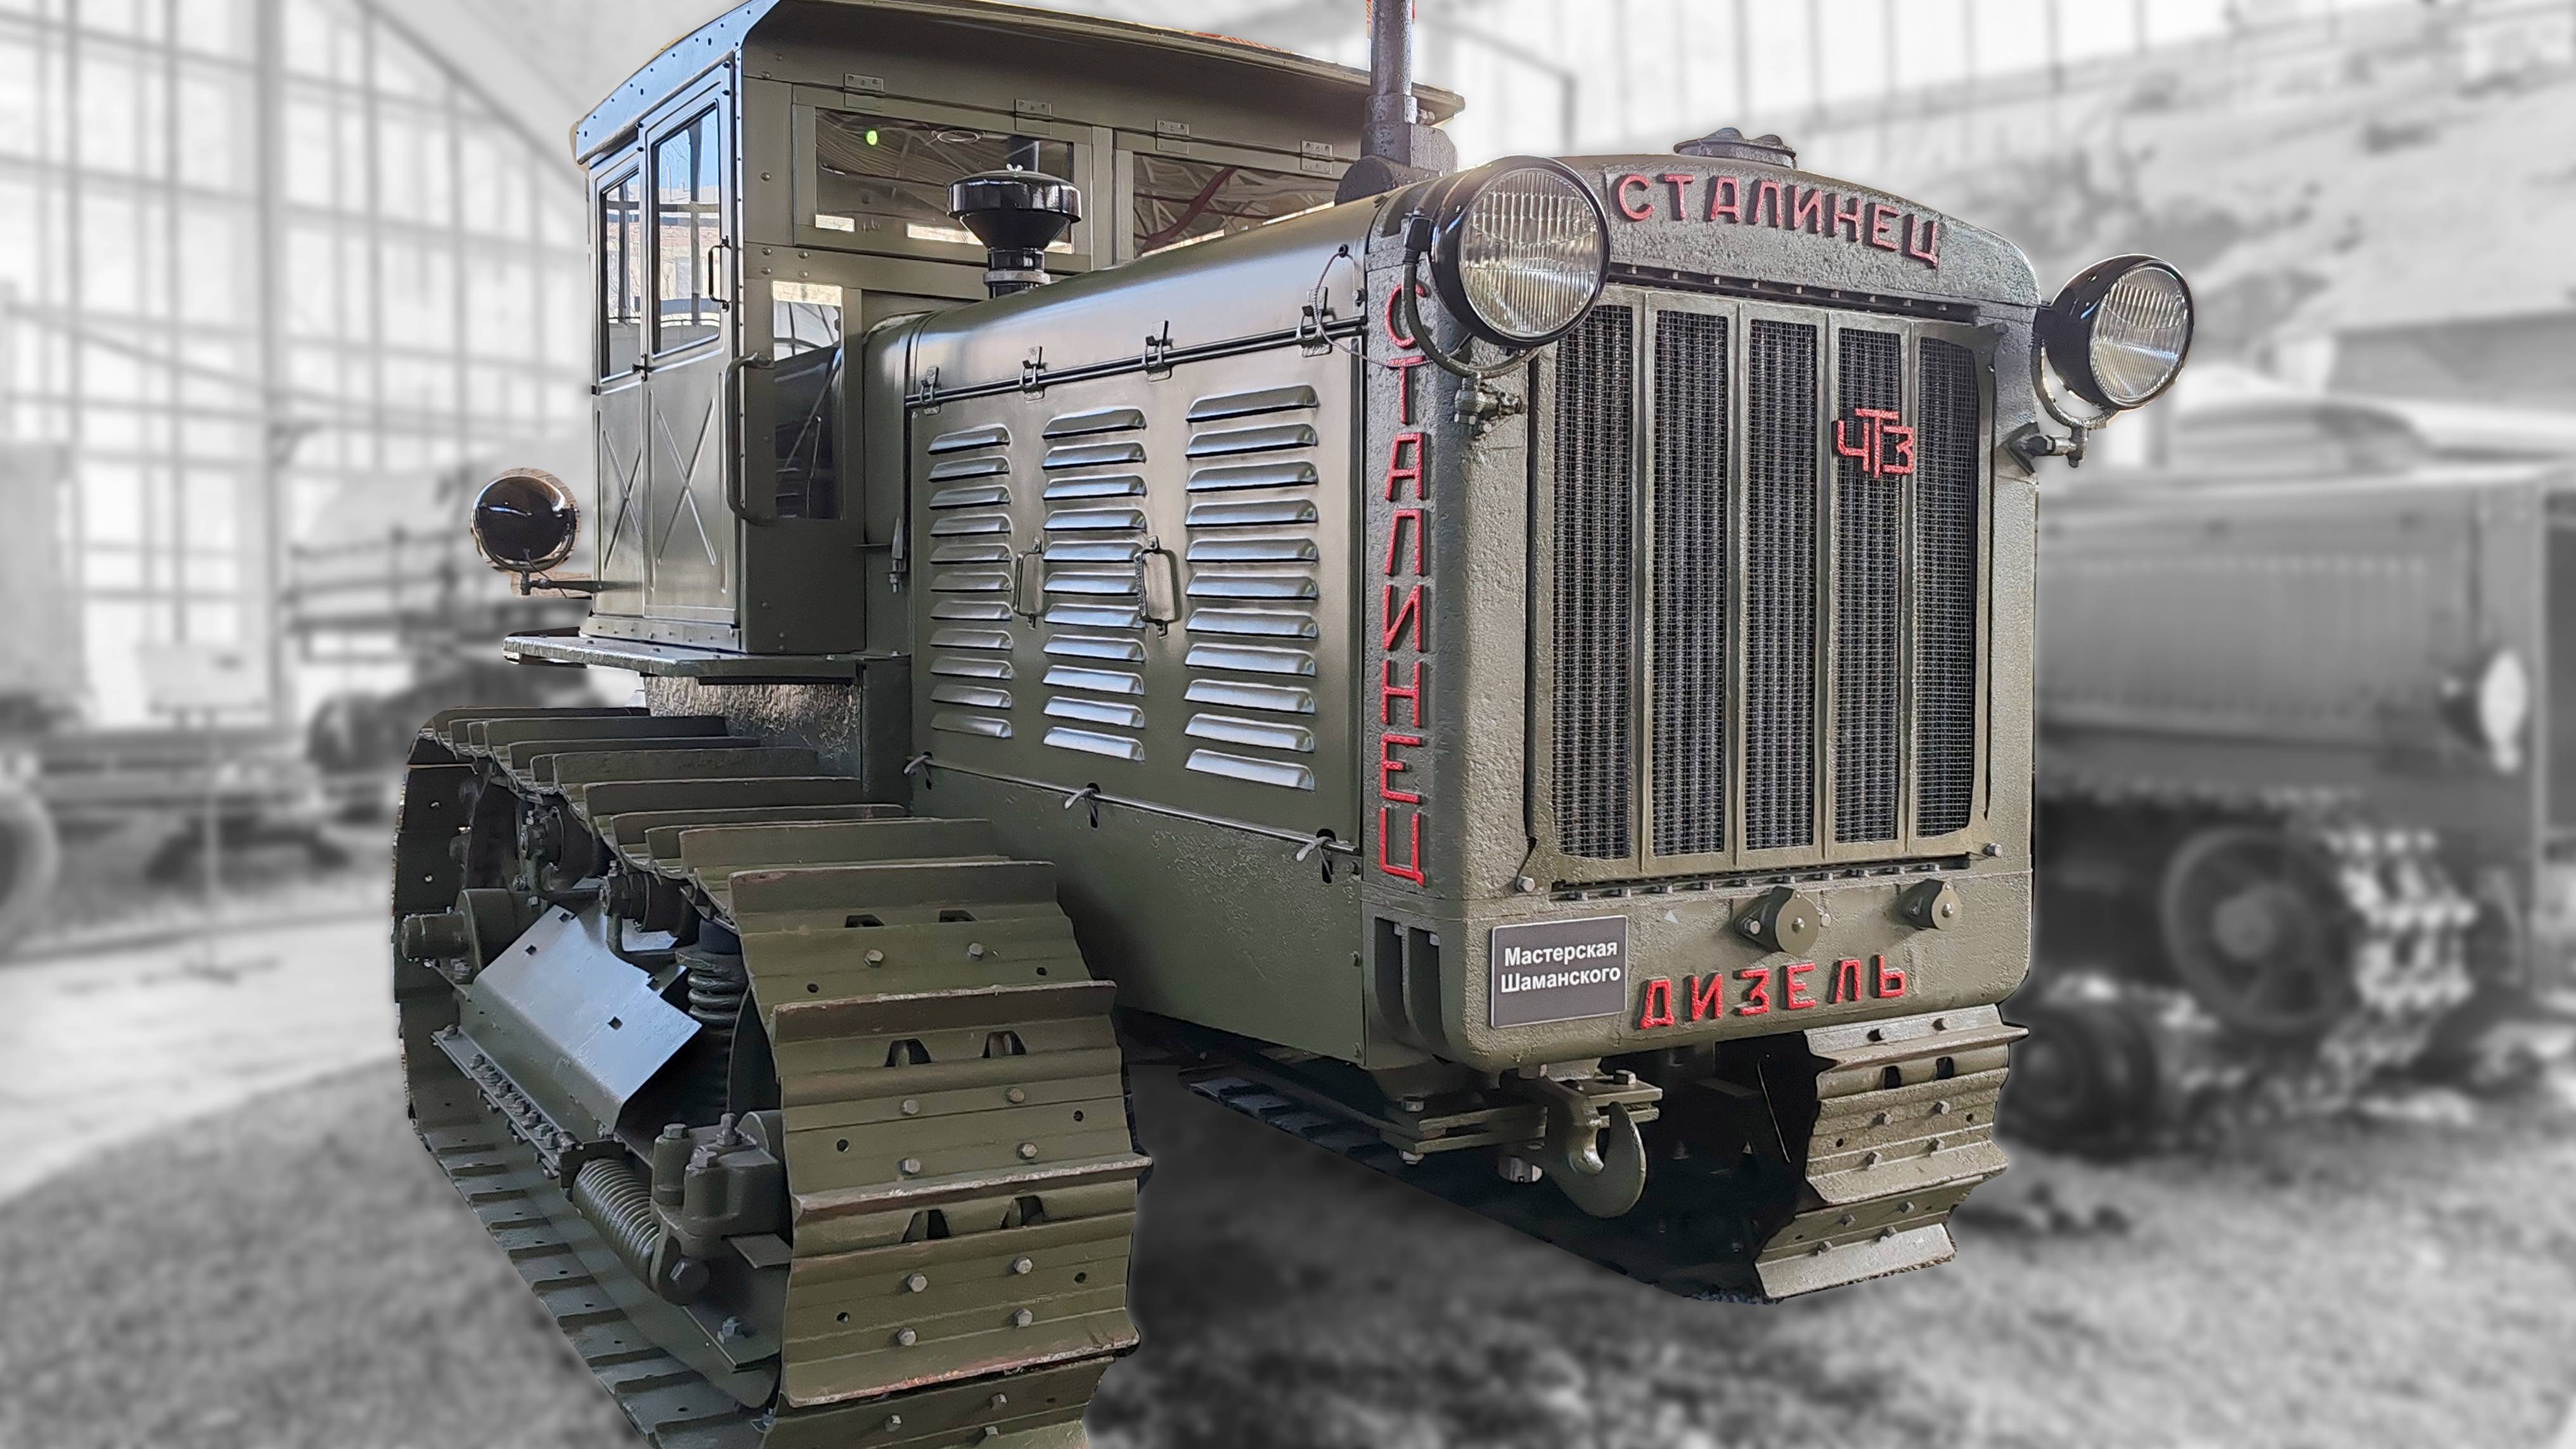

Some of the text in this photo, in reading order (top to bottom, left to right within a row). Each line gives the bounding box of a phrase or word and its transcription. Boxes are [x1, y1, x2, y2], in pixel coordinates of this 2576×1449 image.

[1617, 174, 1938, 269] СТАЛИНЕЦ
[1836, 408, 1915, 479] ЧТЗ
[1379, 283, 1426, 887] СТАЛИНЕЦ
[1500, 967, 1621, 993] Шаманского
[1504, 942, 1618, 967] Мастерская
[1640, 955, 1906, 1029] ДИЗЕЛЬ
